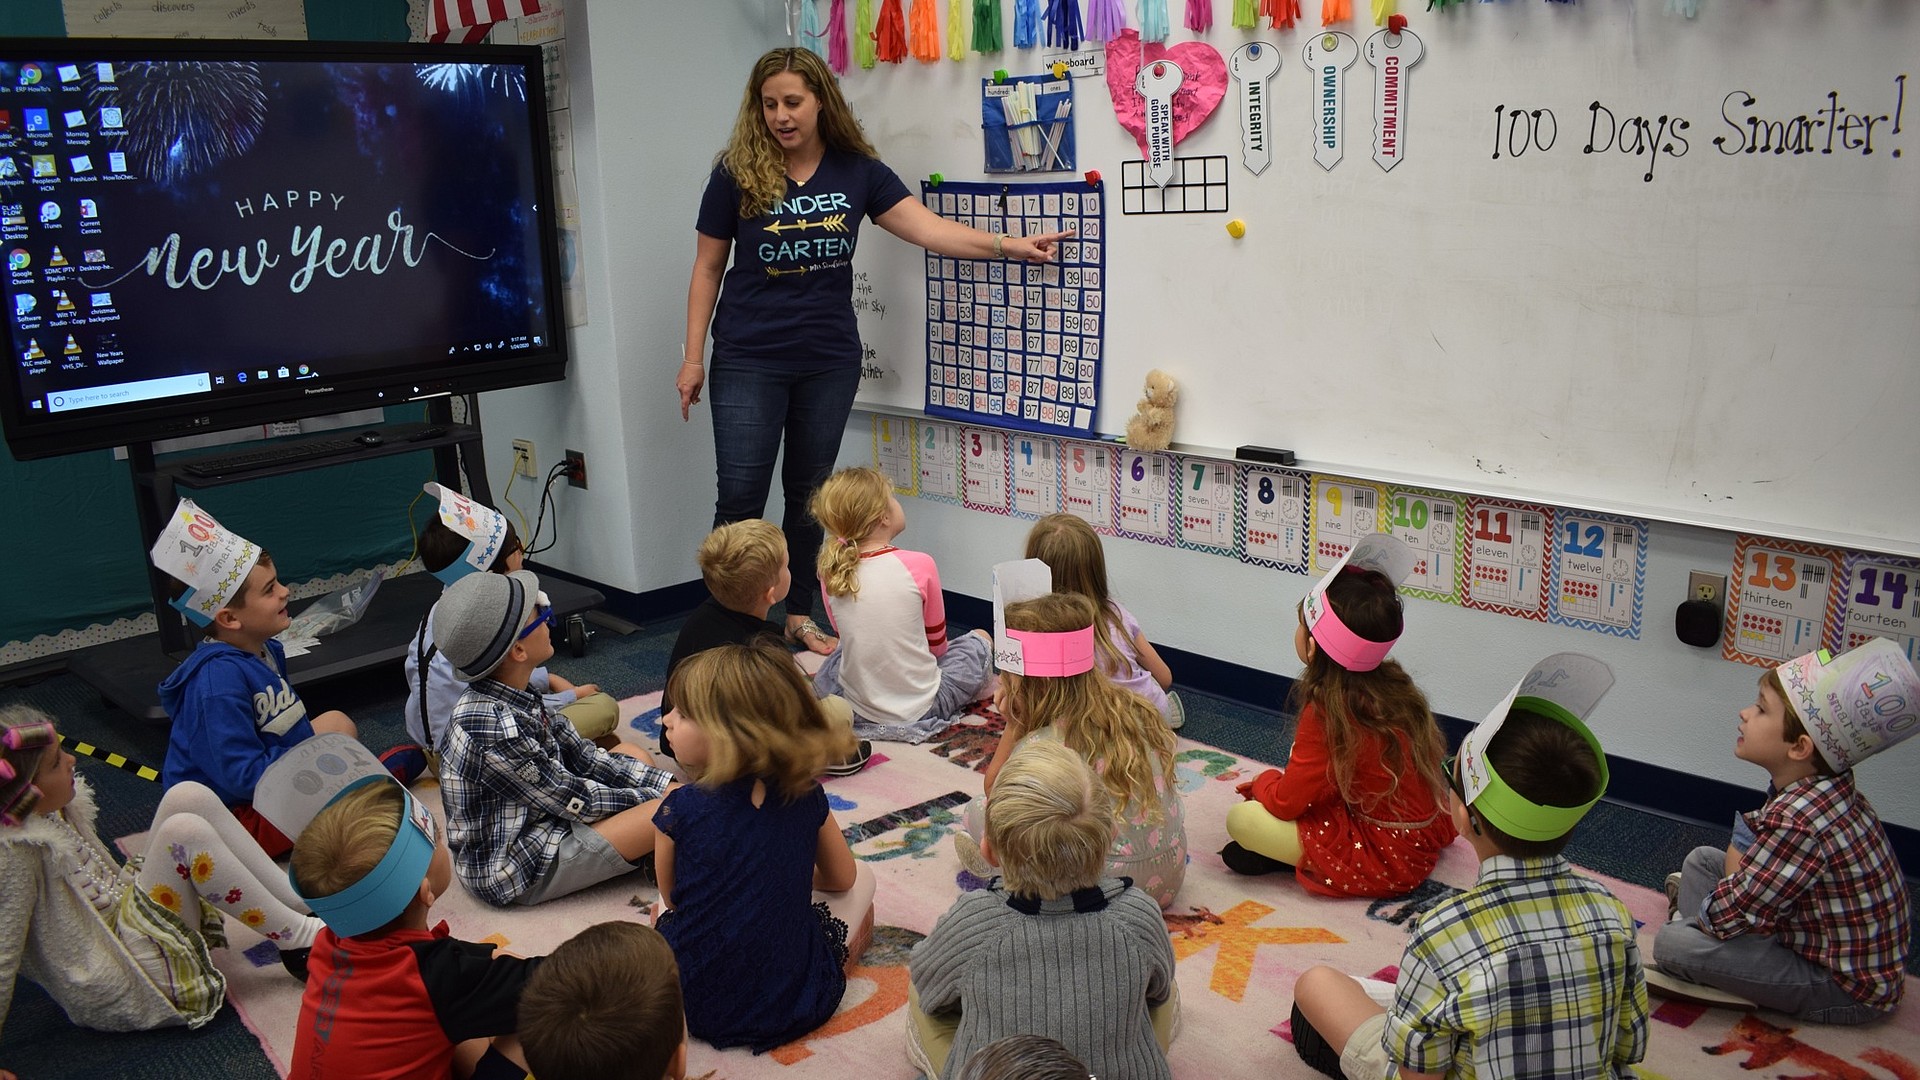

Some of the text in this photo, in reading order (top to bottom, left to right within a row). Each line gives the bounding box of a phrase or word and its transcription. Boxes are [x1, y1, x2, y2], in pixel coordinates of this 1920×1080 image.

[93, 1, 123, 24] collects
[152, 0, 195, 13] discovers
[227, 0, 257, 20] invents
[1046, 56, 1095, 69] weboard
[1249, 81, 1262, 151] INTEGRITY
[1323, 65, 1336, 149] OWNERSHIP
[1382, 56, 1399, 158] COMMITMENT
[1150, 99, 1161, 168] GOOD PURPOSE
[1160, 104, 1170, 161] SPEAK WITH
[1492, 75, 1907, 183] 100 Days Smarter!
[235, 190, 345, 218] HAPPY
[768, 192, 851, 215] INDER
[932, 197, 1096, 211] 1 3 5 7 9 10
[992, 222, 1097, 236] 15 17 19 20
[758, 236, 855, 262] GARTEN
[1065, 246, 1098, 259] 29 30
[930, 262, 1098, 284] 31 33 35 37 39 40
[856, 283, 873, 295] the
[931, 284, 1099, 307] 41 43 45 47 49 50
[88, 314, 120, 323] background
[871, 300, 888, 320] sky.
[930, 304, 1097, 331] 51 53 55 57 59 60
[21, 322, 41, 330] Center
[932, 326, 1098, 355] 61 63 65 67 69 70
[29, 367, 47, 375] player
[98, 358, 124, 366] Wallpaper
[861, 363, 885, 380] ather
[932, 347, 1092, 377] 71 73 75 77 79 80
[933, 369, 1092, 399] 81 83 85 87 89 90
[69, 396, 83, 404] Type
[109, 390, 130, 398] search
[932, 390, 1068, 423] 91 93 95 97 98 99
[881, 419, 892, 442] 1
[925, 426, 936, 449] 2
[971, 433, 983, 457] 3
[1020, 440, 1033, 466] 4
[924, 453, 936, 461] two
[969, 459, 985, 470] three
[1073, 449, 1086, 474] 5
[1021, 466, 1035, 477] four
[1131, 456, 1145, 482] 6
[1191, 463, 1206, 491] 7
[1074, 476, 1087, 487] five
[1131, 485, 1142, 495] six
[1257, 476, 1275, 505] 8
[1188, 494, 1210, 505] seven
[1326, 486, 1343, 517] 9
[1254, 508, 1274, 521] eight
[1325, 519, 1341, 530] nine
[1393, 496, 1429, 530] 10
[1475, 509, 1512, 544] 11
[1404, 533, 1419, 544] ten
[1563, 521, 1605, 559] 12
[1476, 546, 1509, 559] eleven
[1568, 558, 1602, 574] twelve
[1748, 552, 1796, 592] 13
[1743, 590, 1793, 610] thirteen
[1855, 568, 1908, 610] 14
[1848, 608, 1906, 629] fourteen
[1861, 672, 1916, 732] 100
[1855, 699, 1882, 733] days
